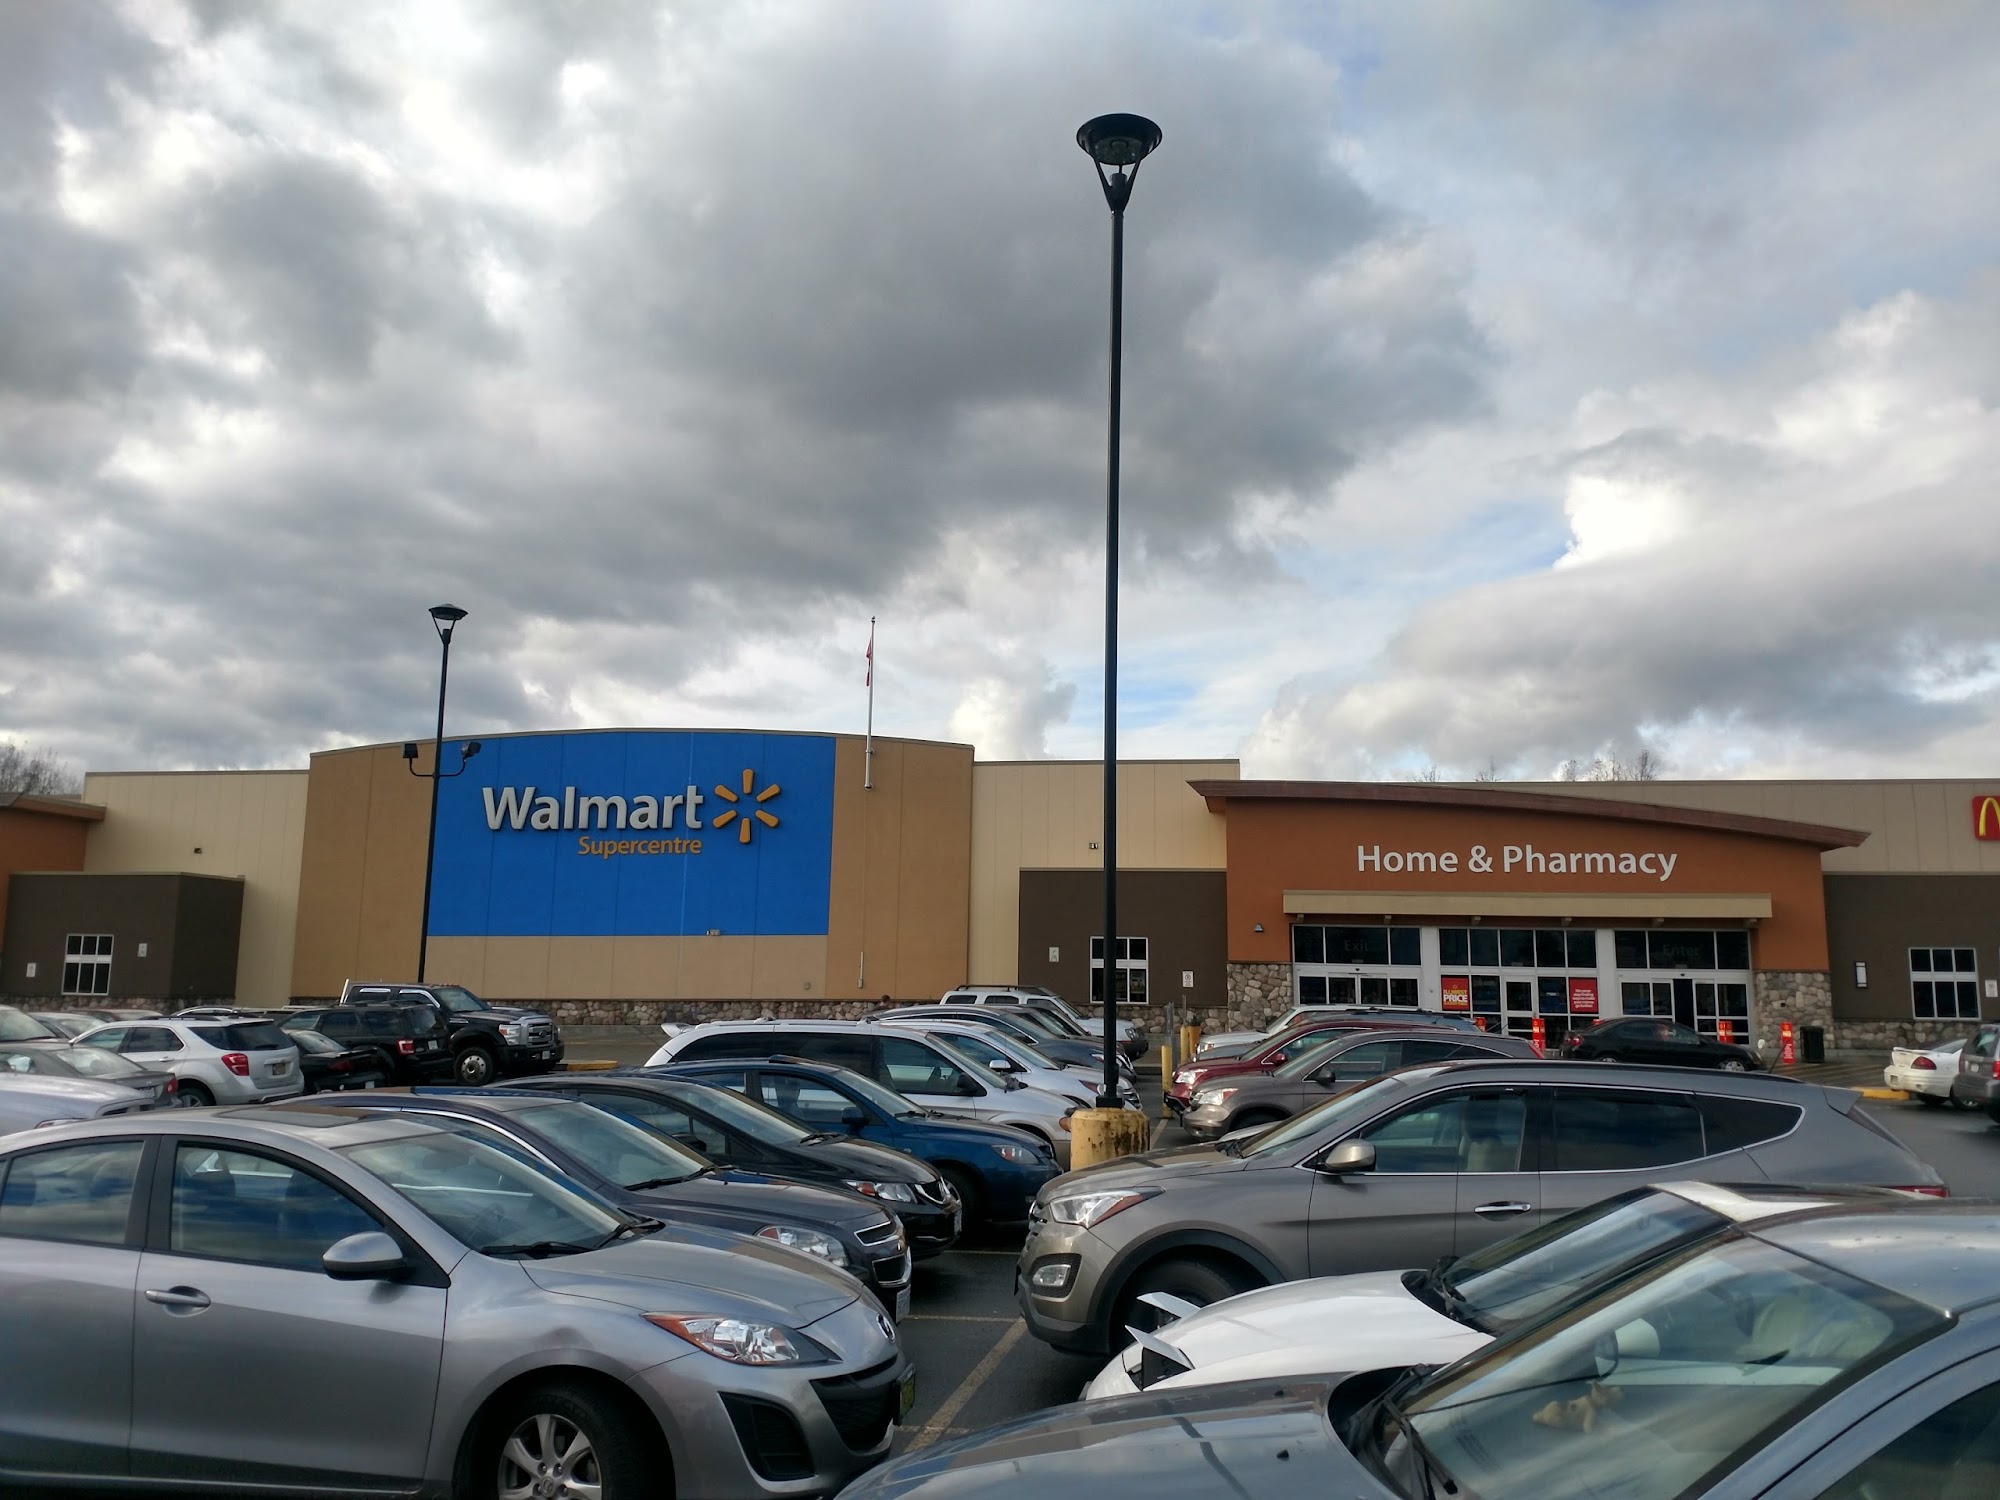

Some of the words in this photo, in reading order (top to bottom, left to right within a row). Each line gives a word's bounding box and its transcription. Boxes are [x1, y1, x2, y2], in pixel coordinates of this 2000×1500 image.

[482, 785, 704, 831] Walmart
[578, 836, 703, 859] Supercentre
[1357, 845, 1458, 873] Home
[1467, 845, 1494, 873] &
[1503, 844, 1678, 882] Pharmacy
[1344, 939, 1369, 951] Exit
[1443, 994, 1468, 1003] PRICE
